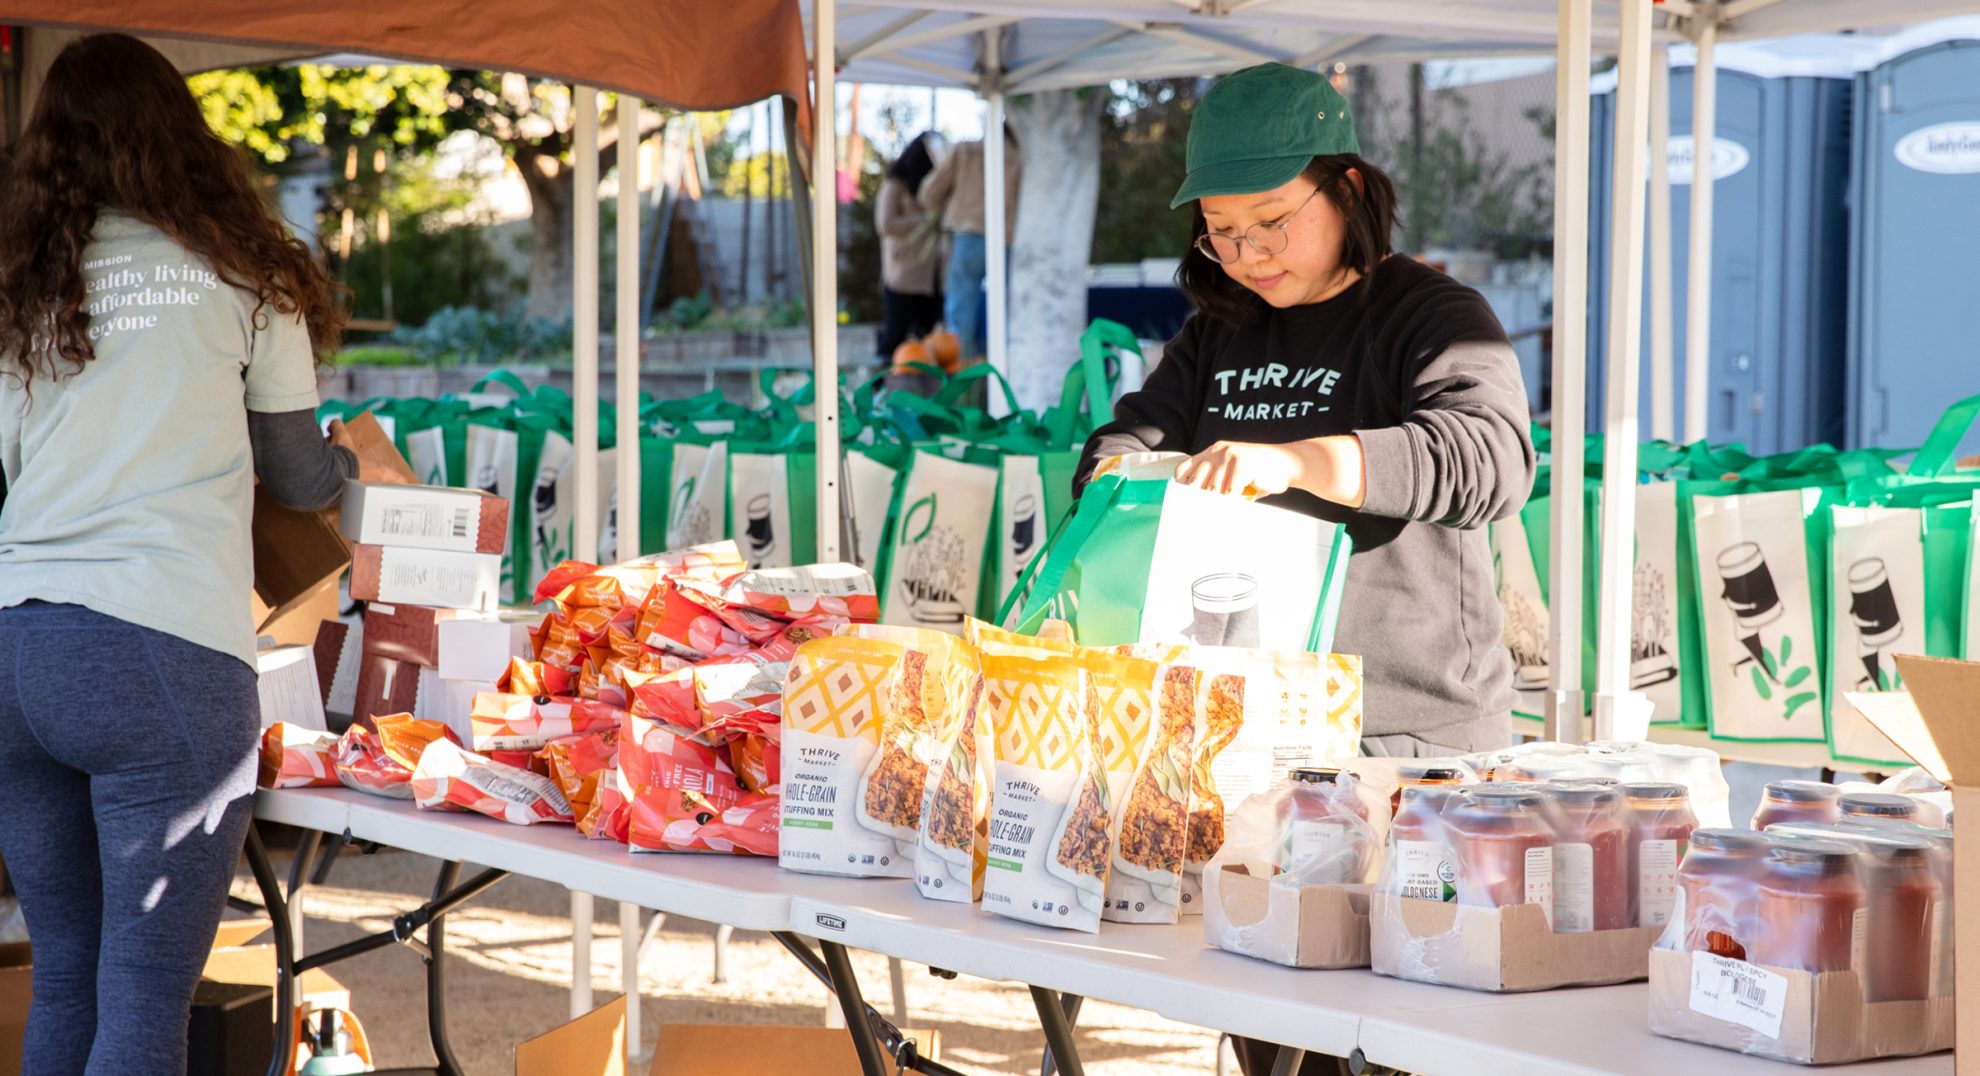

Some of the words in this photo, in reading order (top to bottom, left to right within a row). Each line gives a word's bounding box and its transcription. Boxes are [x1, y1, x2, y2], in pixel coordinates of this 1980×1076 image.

[84, 254, 132, 270] MISSION
[85, 269, 148, 293] ealthy
[155, 264, 217, 290] living
[89, 286, 200, 317] affordable
[88, 314, 158, 339] eryone
[1214, 362, 1342, 396] THRIVE
[1224, 401, 1314, 421] MARKET
[800, 747, 841, 761] THRIVE
[804, 758, 833, 767] MARKET
[795, 773, 828, 783] ORGANIC
[1006, 780, 1040, 796] THRIVE
[1008, 792, 1033, 802] MARKET
[817, 808, 834, 818] MIX
[998, 808, 1029, 821] ORGANIC
[1012, 848, 1027, 859] MIX
[818, 916, 843, 929] LIFETIME
[1712, 957, 1736, 969] THRIVE
